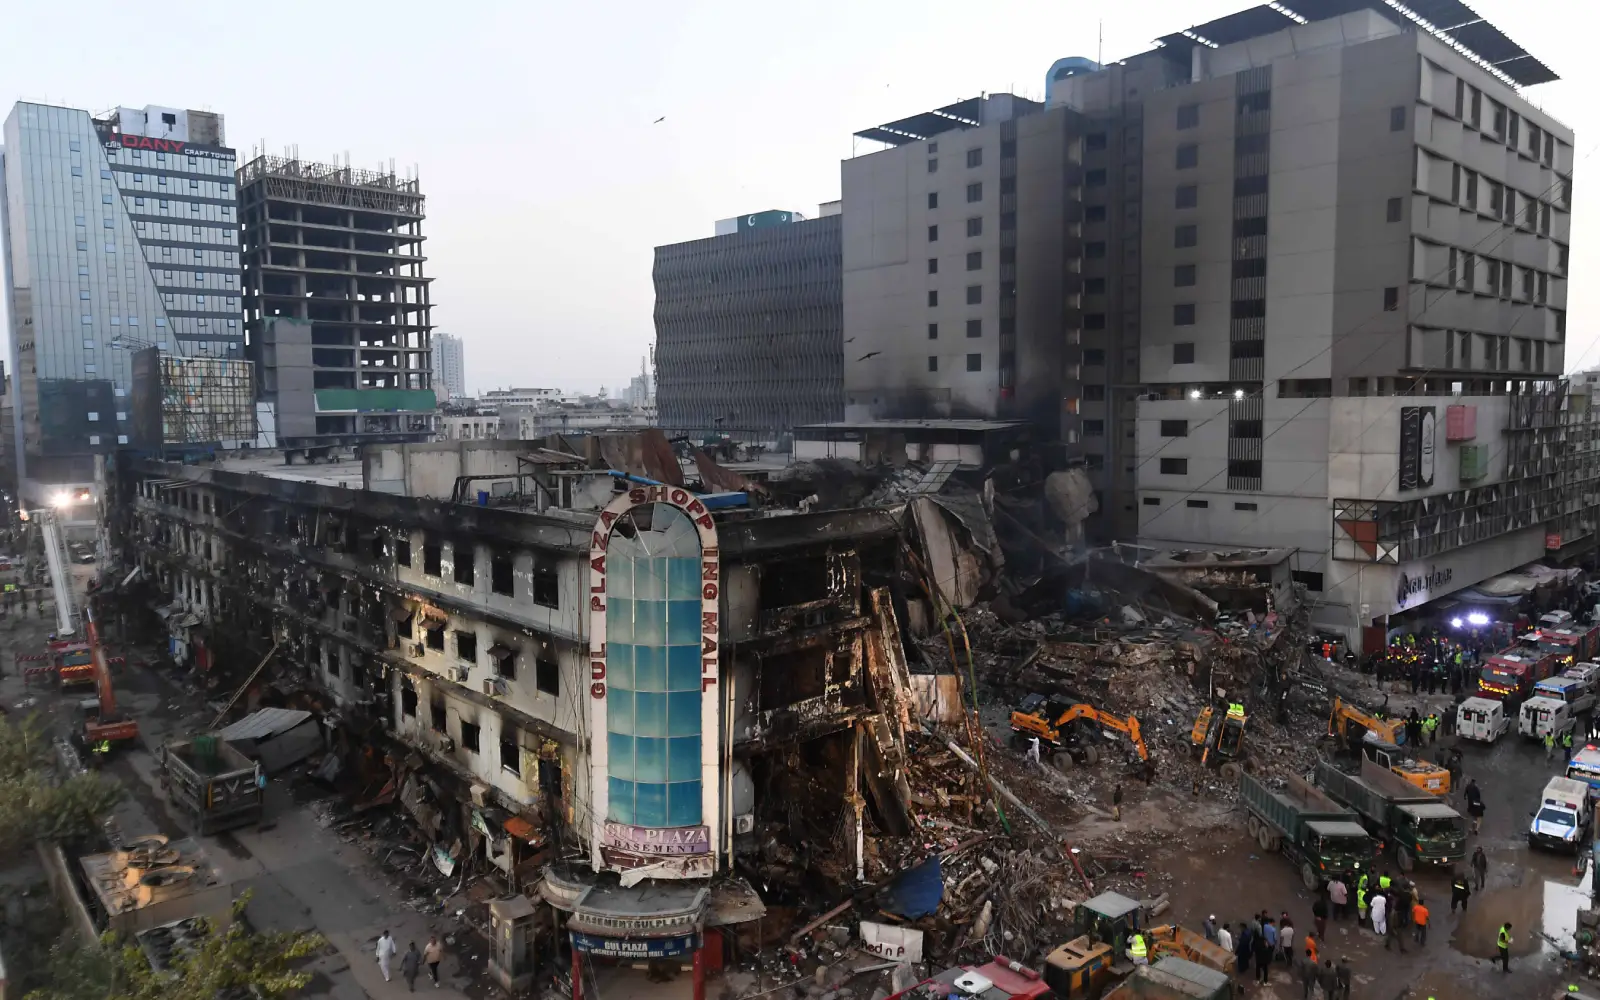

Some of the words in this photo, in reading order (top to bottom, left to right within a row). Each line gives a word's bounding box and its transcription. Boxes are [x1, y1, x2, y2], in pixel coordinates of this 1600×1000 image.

[122, 134, 185, 152] DANY
[184, 148, 209, 157] CRAFT
[210, 151, 236, 160] TOWER
[591, 511, 618, 612] PLAZA
[701, 611, 718, 693] MALL
[591, 643, 606, 699] GUL
[604, 823, 635, 840] GUL
[645, 829, 708, 843] PLAZA
[614, 839, 697, 853] BASEMENT
[578, 914, 633, 928] BASEMENT
[634, 919, 654, 929] GUL
[656, 915, 692, 928] PLAZA
[604, 941, 620, 951] GUL
[622, 943, 648, 951] PLAZA
